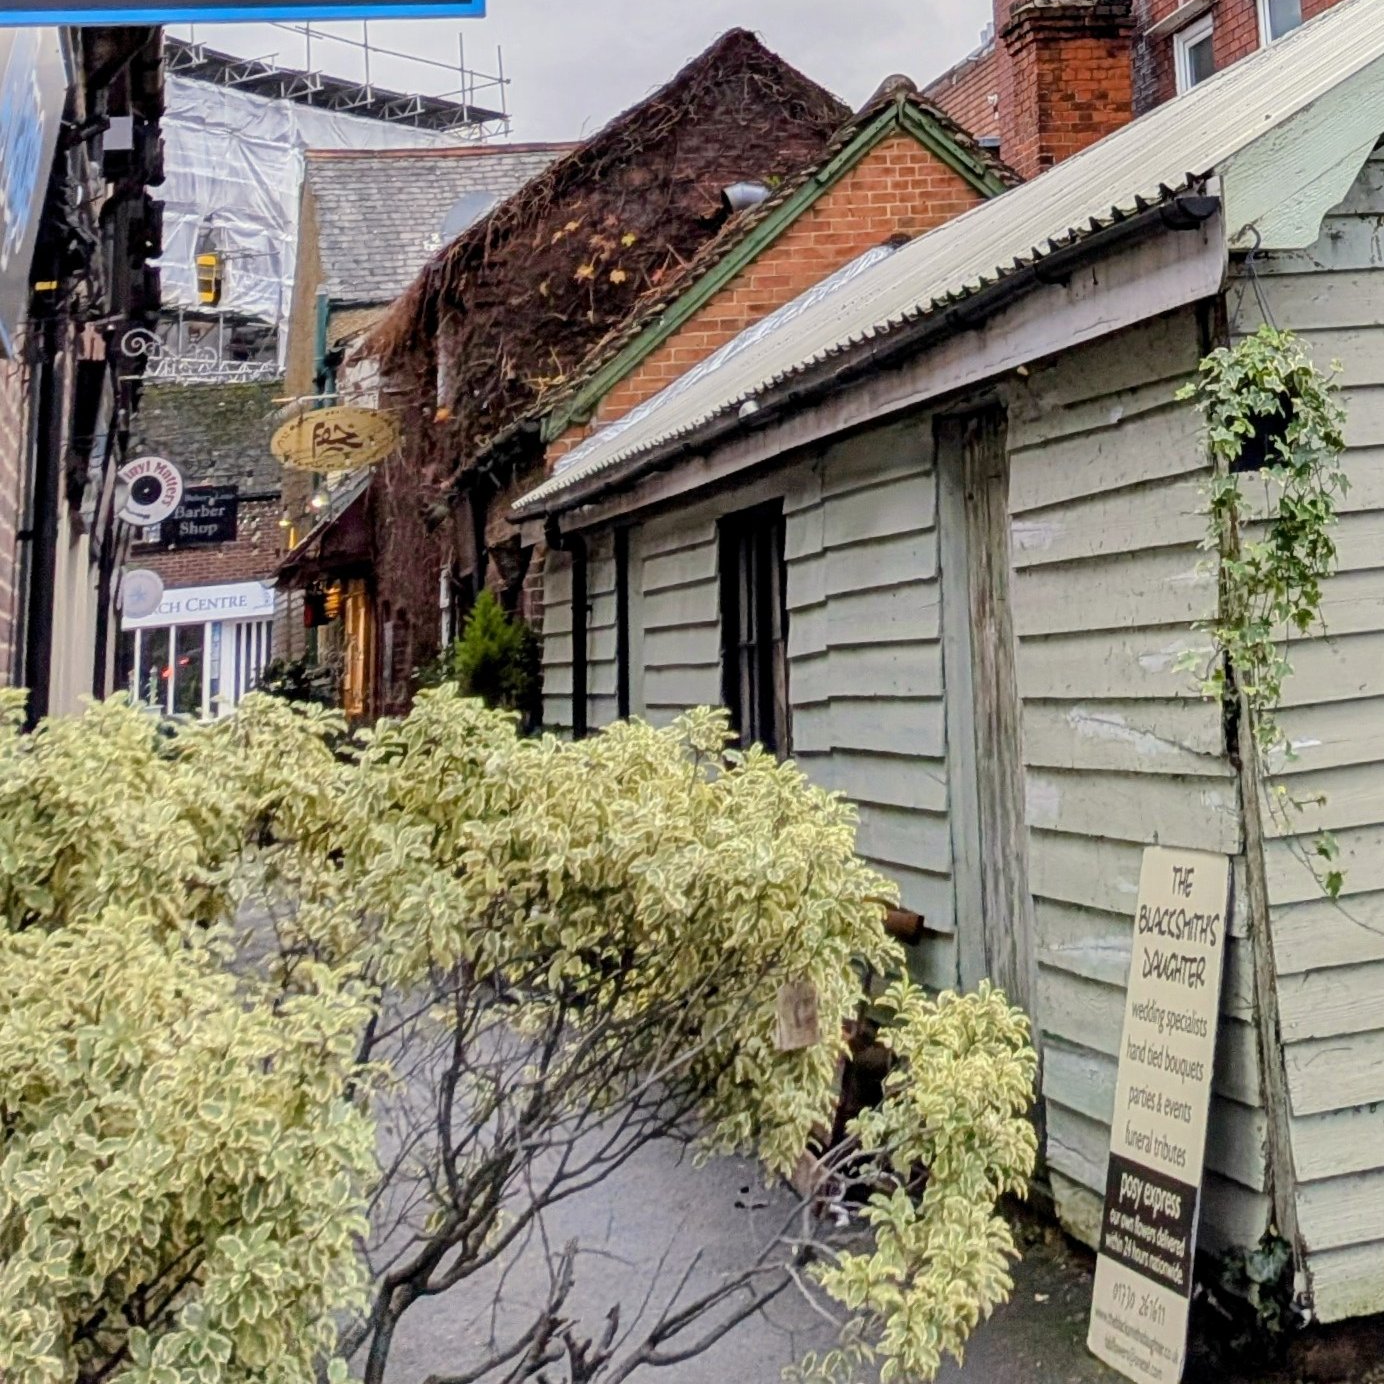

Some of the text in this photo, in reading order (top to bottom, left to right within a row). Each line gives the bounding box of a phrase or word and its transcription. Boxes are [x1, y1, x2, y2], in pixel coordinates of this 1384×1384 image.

[123, 459, 178, 507] inyl Matters
[174, 505, 226, 519] Barber
[179, 521, 218, 536] Shop
[186, 595, 248, 612] CENTRE
[1172, 866, 1195, 899] THE
[1138, 904, 1220, 947] BLACKSMITH'S
[1142, 946, 1207, 989] DAUGHTER
[1132, 998, 1207, 1038] wedding specialists
[1127, 1034, 1204, 1084] hand tied bouquets
[1128, 1084, 1193, 1123] parties & events
[1125, 1120, 1187, 1168] funeral tributes
[1119, 1172, 1182, 1219] posy express
[1110, 1208, 1121, 1223] our
[1120, 1213, 1135, 1230] own
[1157, 1226, 1186, 1258] delivered
[1133, 1238, 1150, 1267] hours
